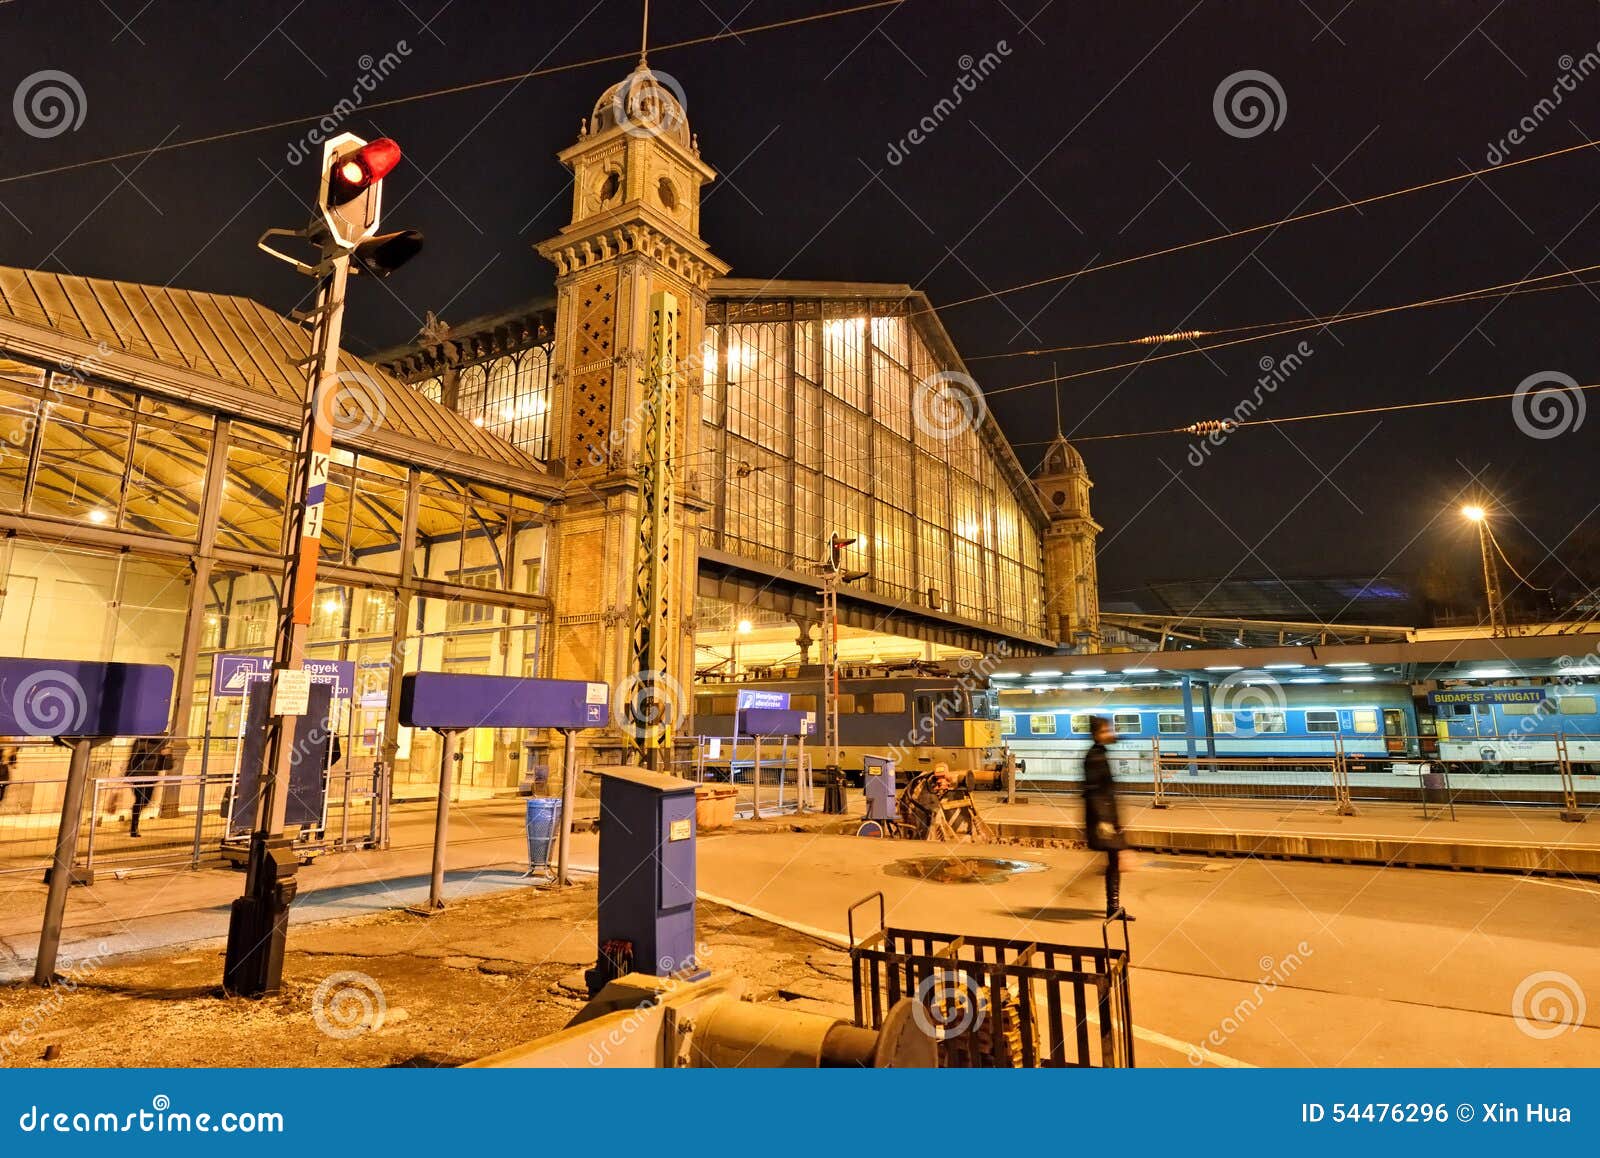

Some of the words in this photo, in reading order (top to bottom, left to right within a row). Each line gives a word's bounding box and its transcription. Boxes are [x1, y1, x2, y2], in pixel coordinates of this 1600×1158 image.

[314, 456, 326, 477] K
[1434, 693, 1484, 703] BUDAPEST
[1494, 692, 1540, 702] NYUGATI
